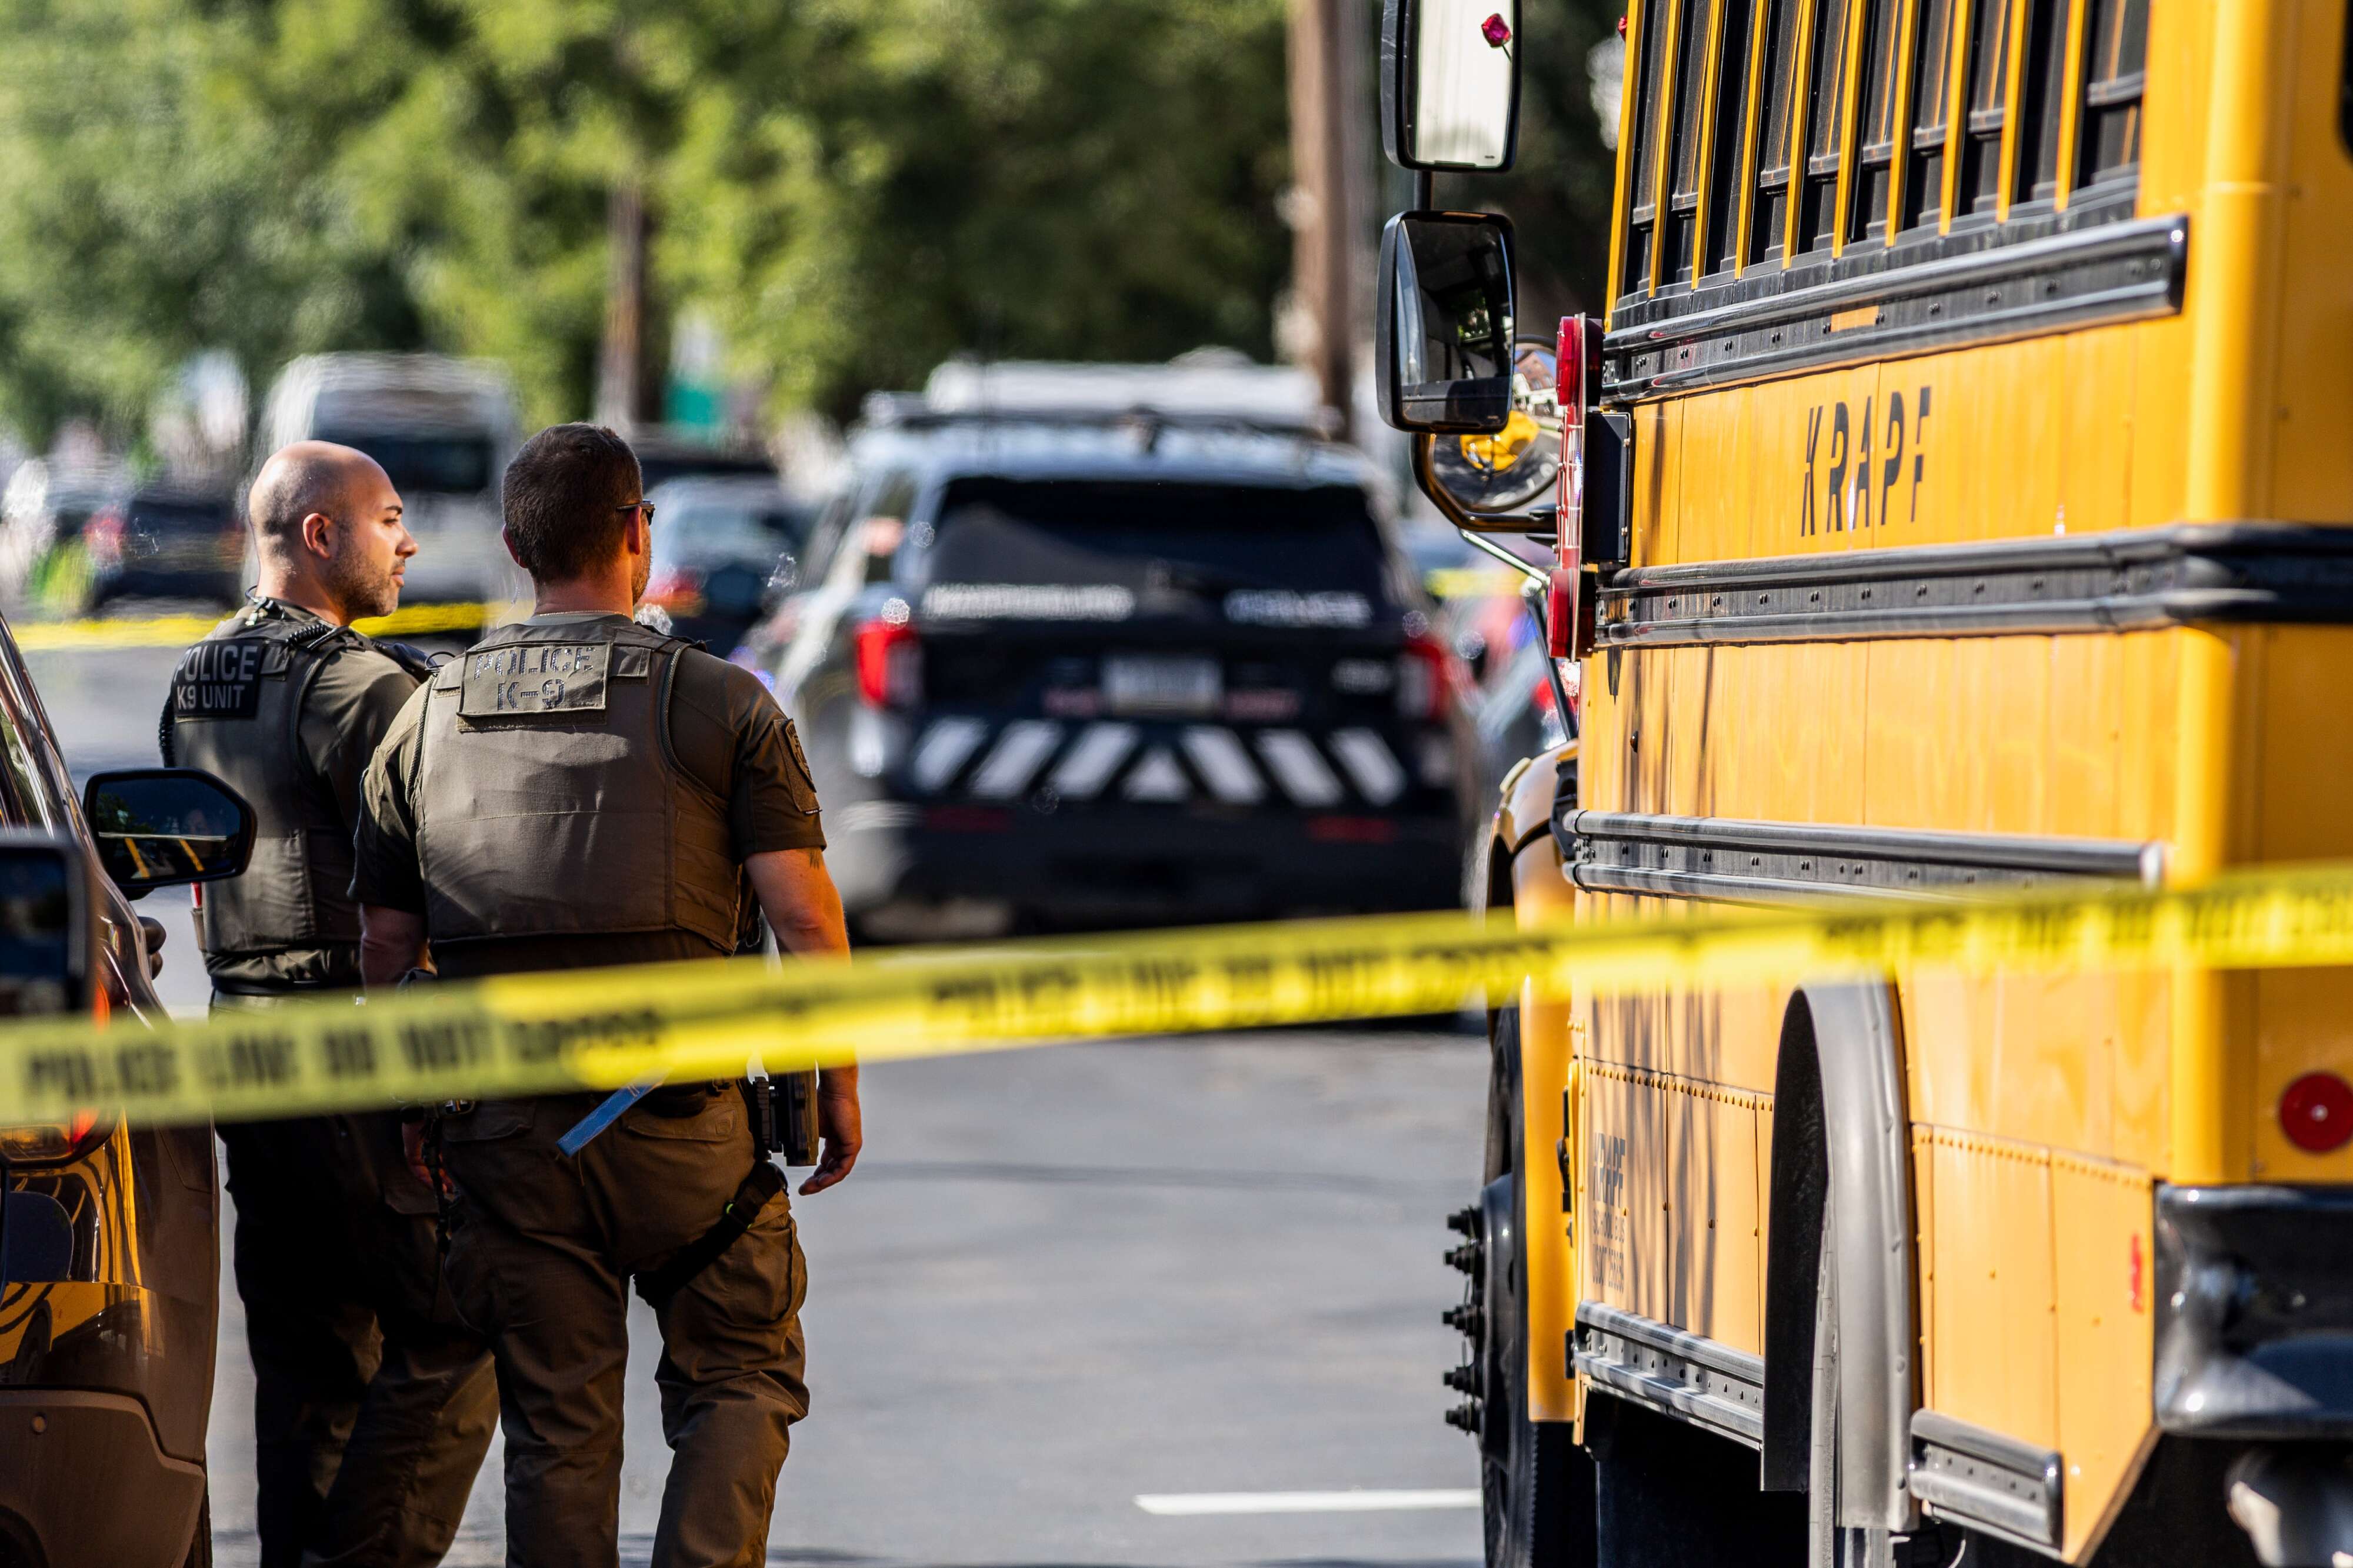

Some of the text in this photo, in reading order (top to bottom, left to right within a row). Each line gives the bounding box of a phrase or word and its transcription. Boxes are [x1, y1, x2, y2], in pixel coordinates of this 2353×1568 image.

[1801, 386, 1931, 536] KRAPF
[174, 645, 258, 683] POLICE
[474, 647, 597, 680] POLICE
[177, 685, 245, 710] K9 UNIT
[497, 679, 565, 712] K-9
